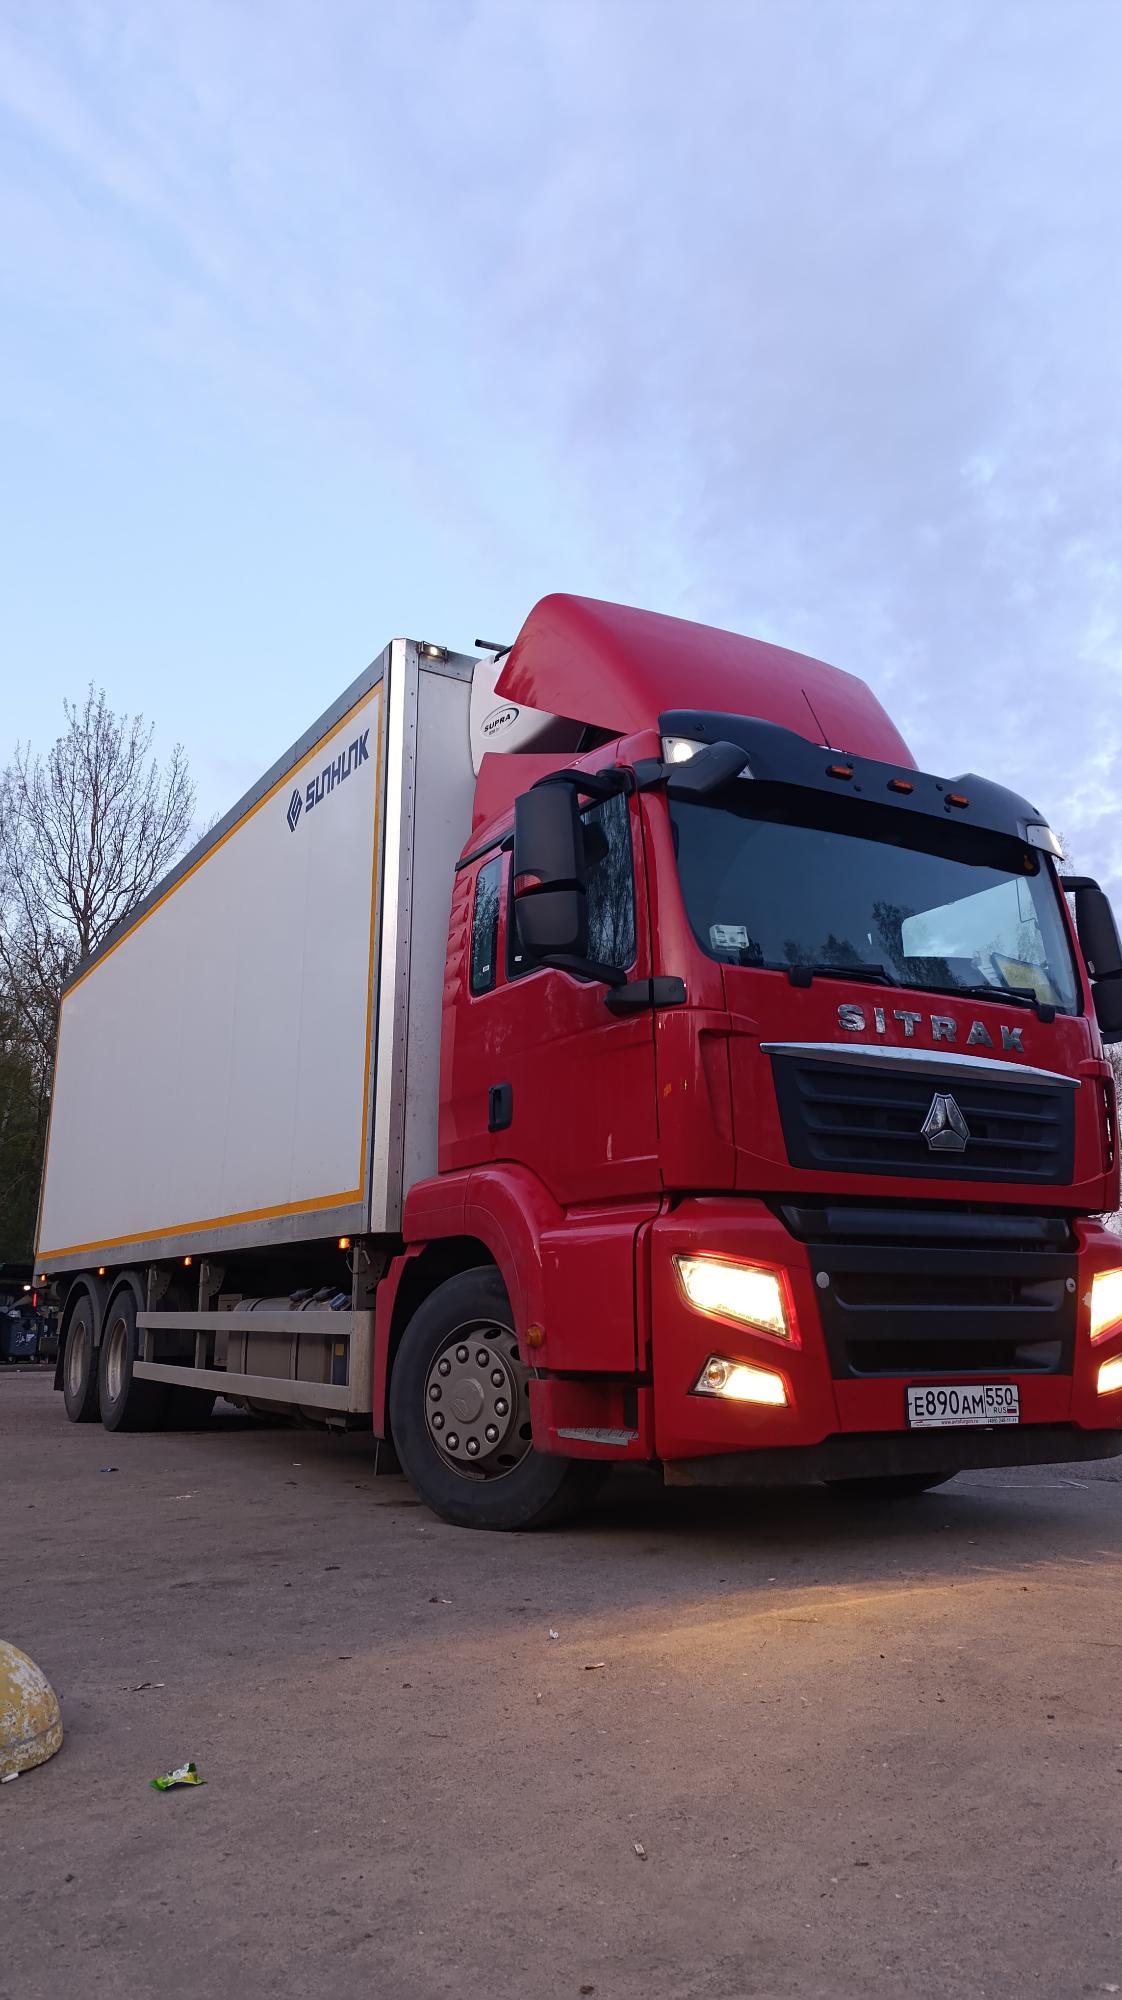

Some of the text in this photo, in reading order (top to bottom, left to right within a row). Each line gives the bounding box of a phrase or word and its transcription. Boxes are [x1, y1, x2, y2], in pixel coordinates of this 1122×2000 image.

[484, 713, 511, 732] SUPRA
[837, 1003, 1025, 1052] SITRAK
[985, 1388, 1013, 1406] 550
[993, 1406, 1007, 1414] RUS
